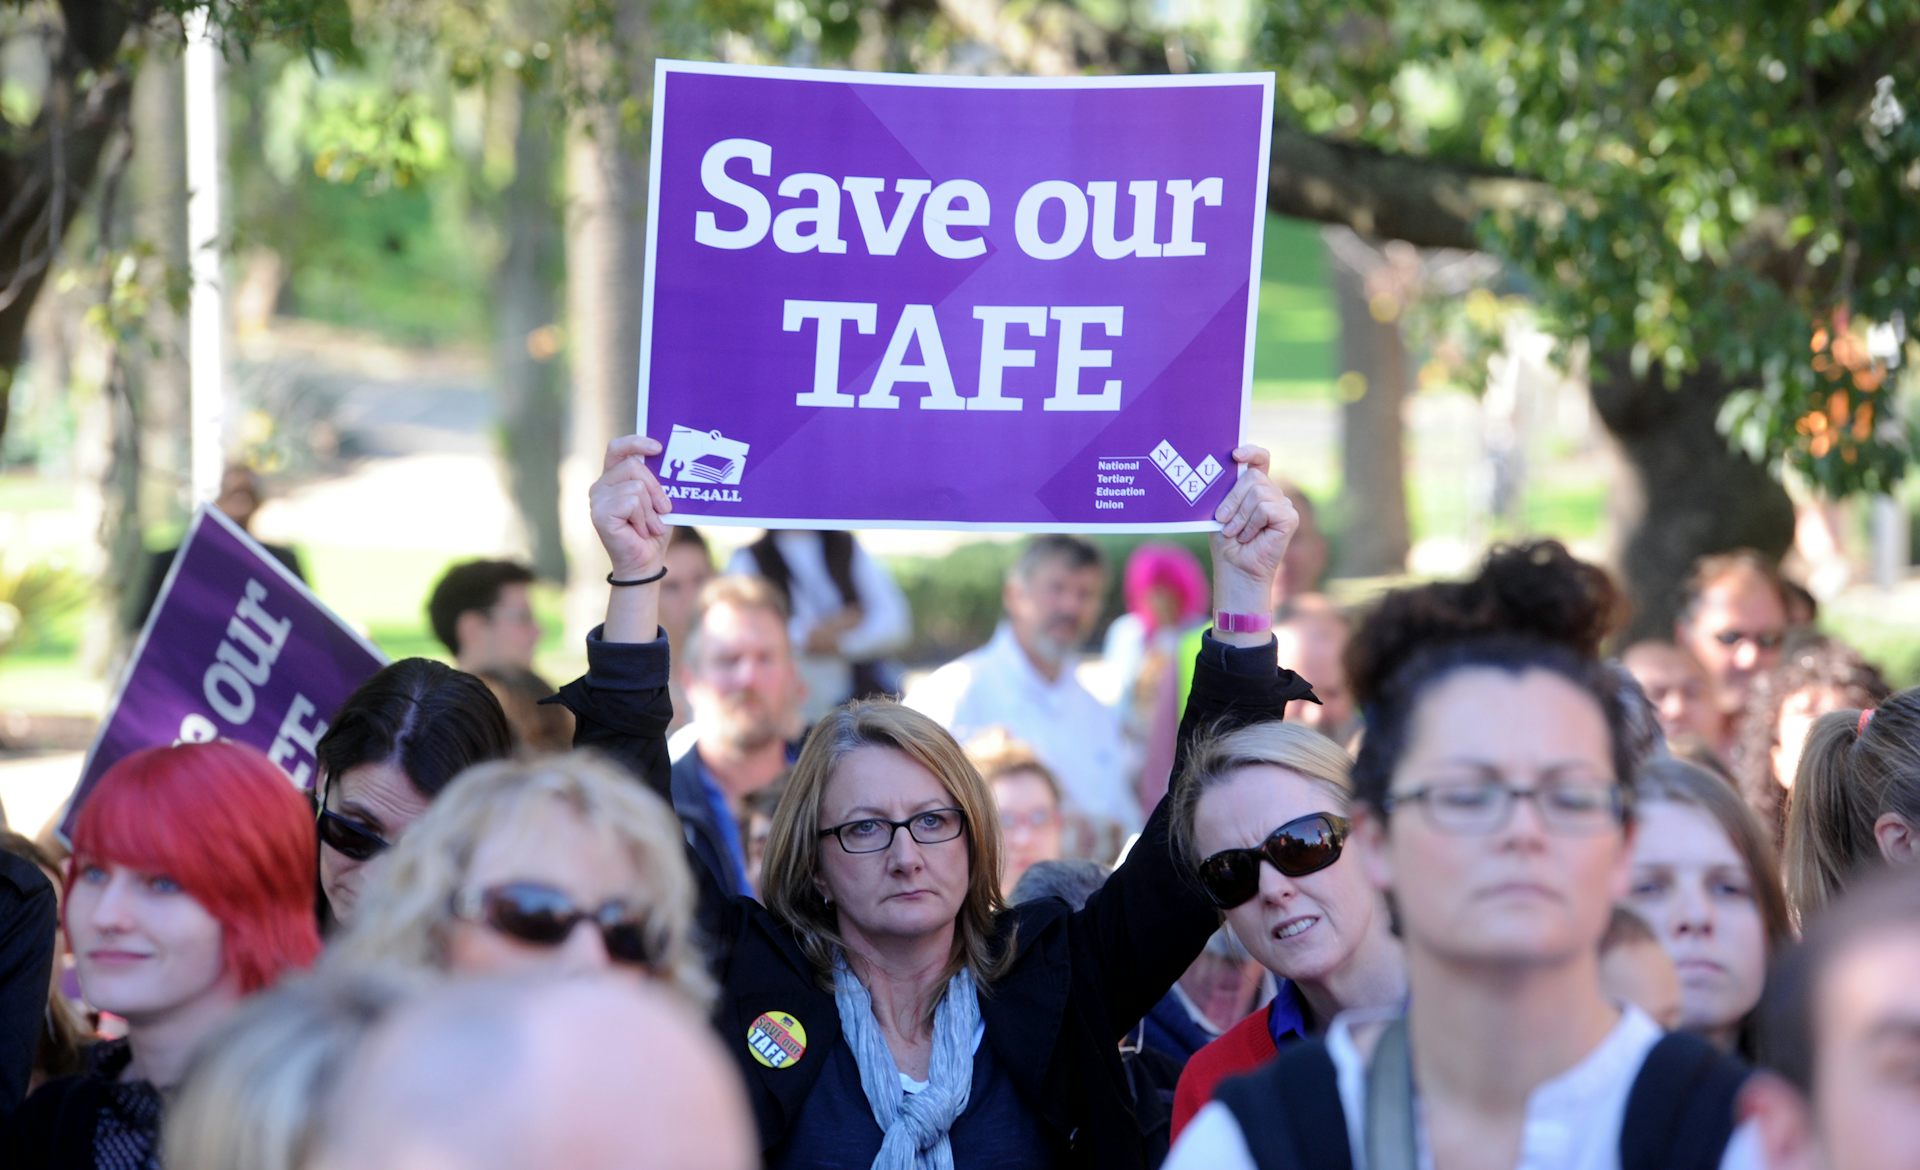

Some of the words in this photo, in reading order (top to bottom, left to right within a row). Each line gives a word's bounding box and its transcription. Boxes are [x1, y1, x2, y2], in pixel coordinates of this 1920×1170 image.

[694, 137, 992, 261] Save
[1013, 176, 1224, 261] our
[782, 299, 1125, 412] TAFE
[1098, 461, 1139, 471] National
[1097, 474, 1135, 484] Tertiary
[1095, 500, 1124, 509] Union
[1096, 487, 1146, 497] Education
[203, 578, 293, 726] our
[756, 1016, 784, 1041] SAVE
[747, 1027, 789, 1068] TAFE
